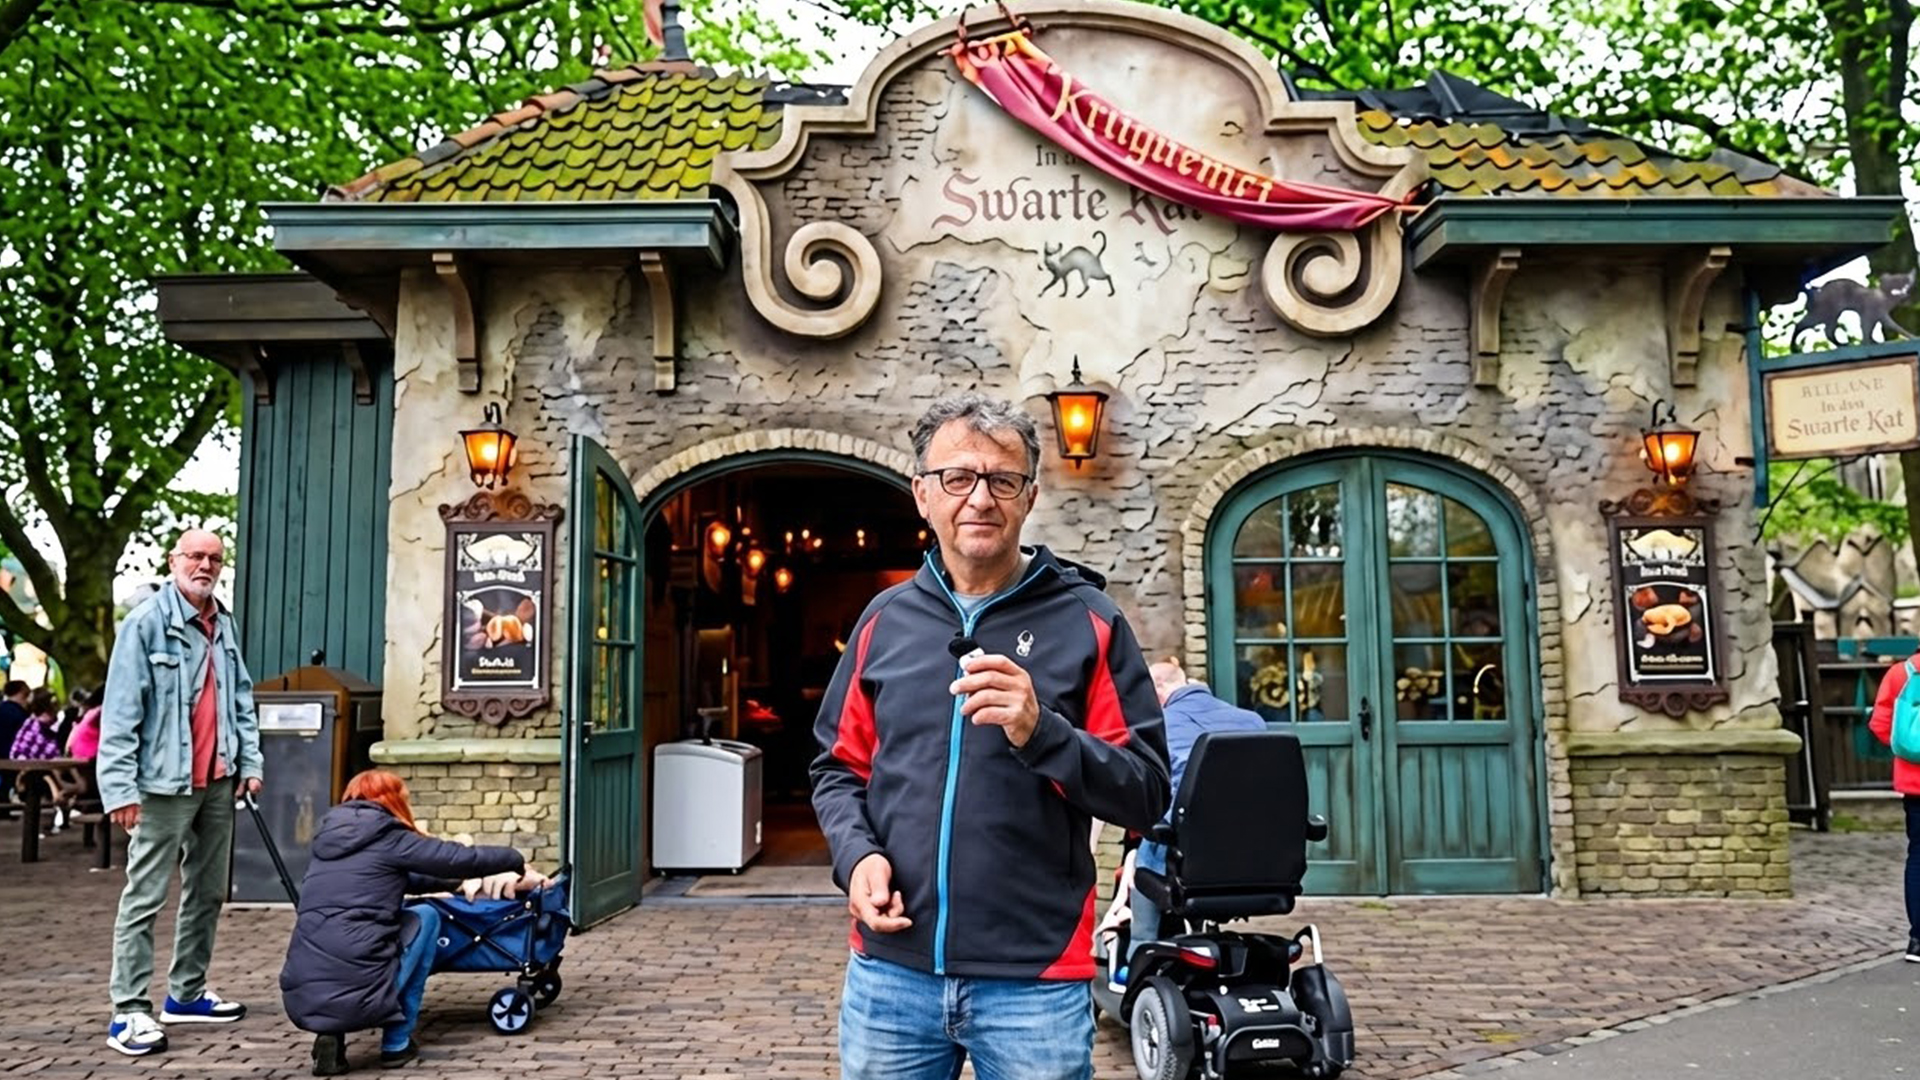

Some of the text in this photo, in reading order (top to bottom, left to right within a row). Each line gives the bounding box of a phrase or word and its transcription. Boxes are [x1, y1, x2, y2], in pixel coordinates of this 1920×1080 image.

[1036, 144, 1057, 167] In
[931, 172, 1109, 228] Swarte
[1821, 400, 1836, 413] In
[1786, 408, 1904, 440] Swarte Kat
